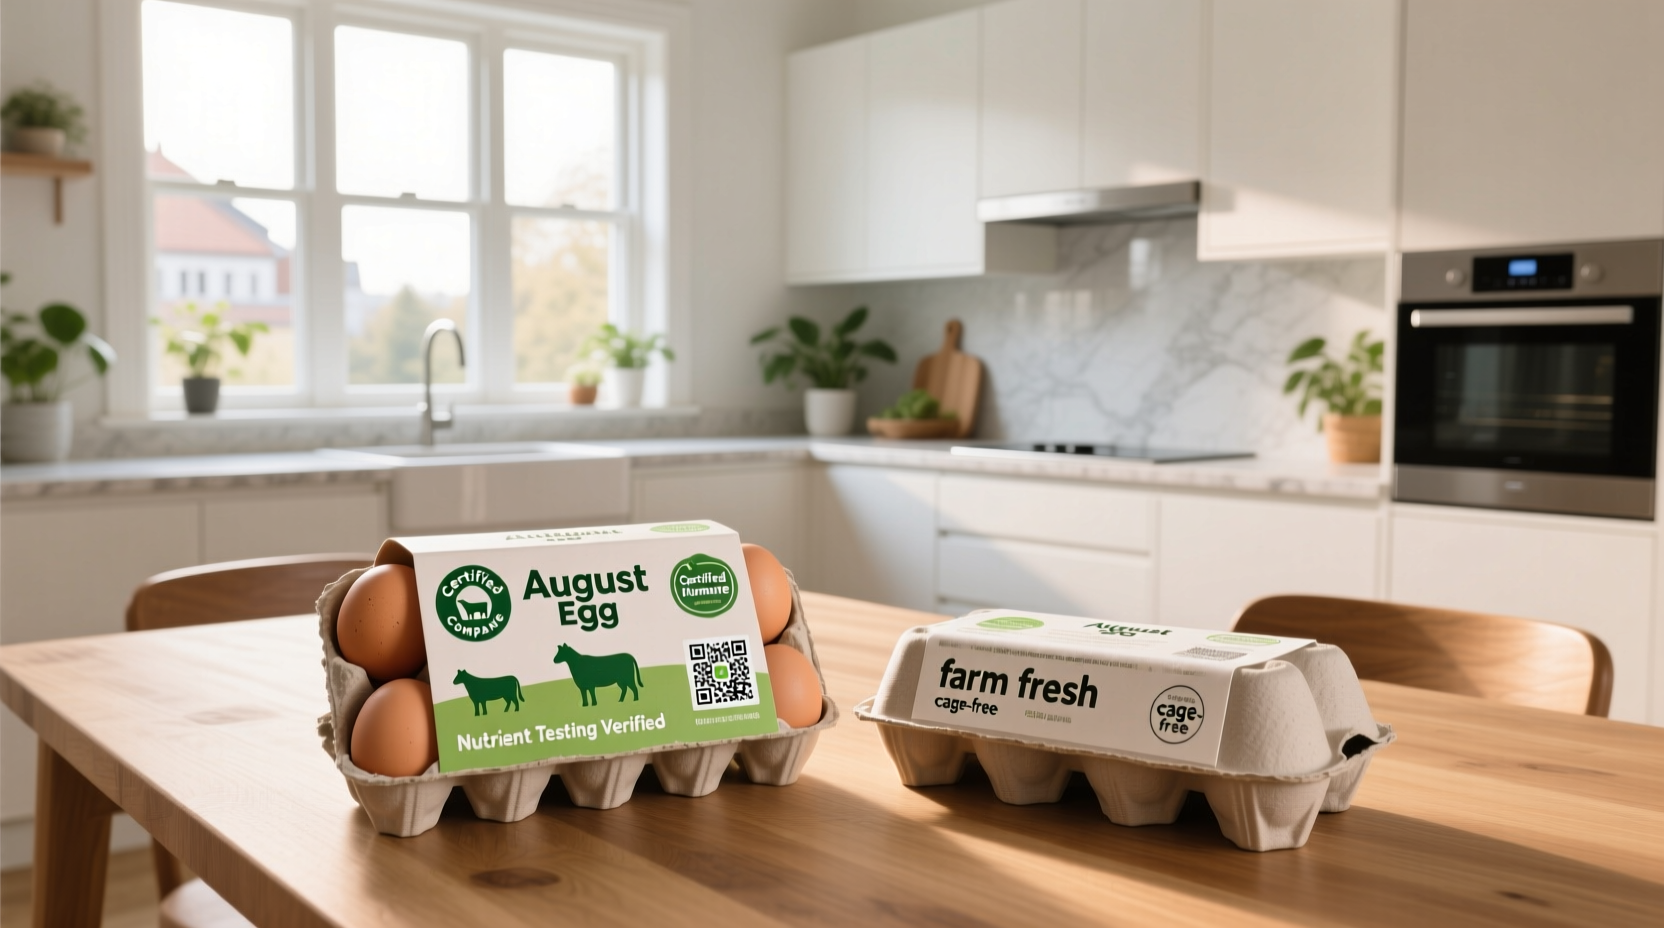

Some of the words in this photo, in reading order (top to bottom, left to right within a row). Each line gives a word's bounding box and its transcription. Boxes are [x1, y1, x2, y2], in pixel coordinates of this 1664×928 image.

[523, 564, 649, 602] August
[558, 600, 619, 632] Egg
[939, 658, 1009, 696] farm
[1017, 667, 1098, 709] fresh
[934, 697, 998, 715] cage-free
[1156, 703, 1203, 723] cage-
[457, 728, 533, 752] Nutrient
[535, 722, 598, 743] Testing
[600, 712, 666, 735] Verified
[1159, 717, 1189, 735] free
